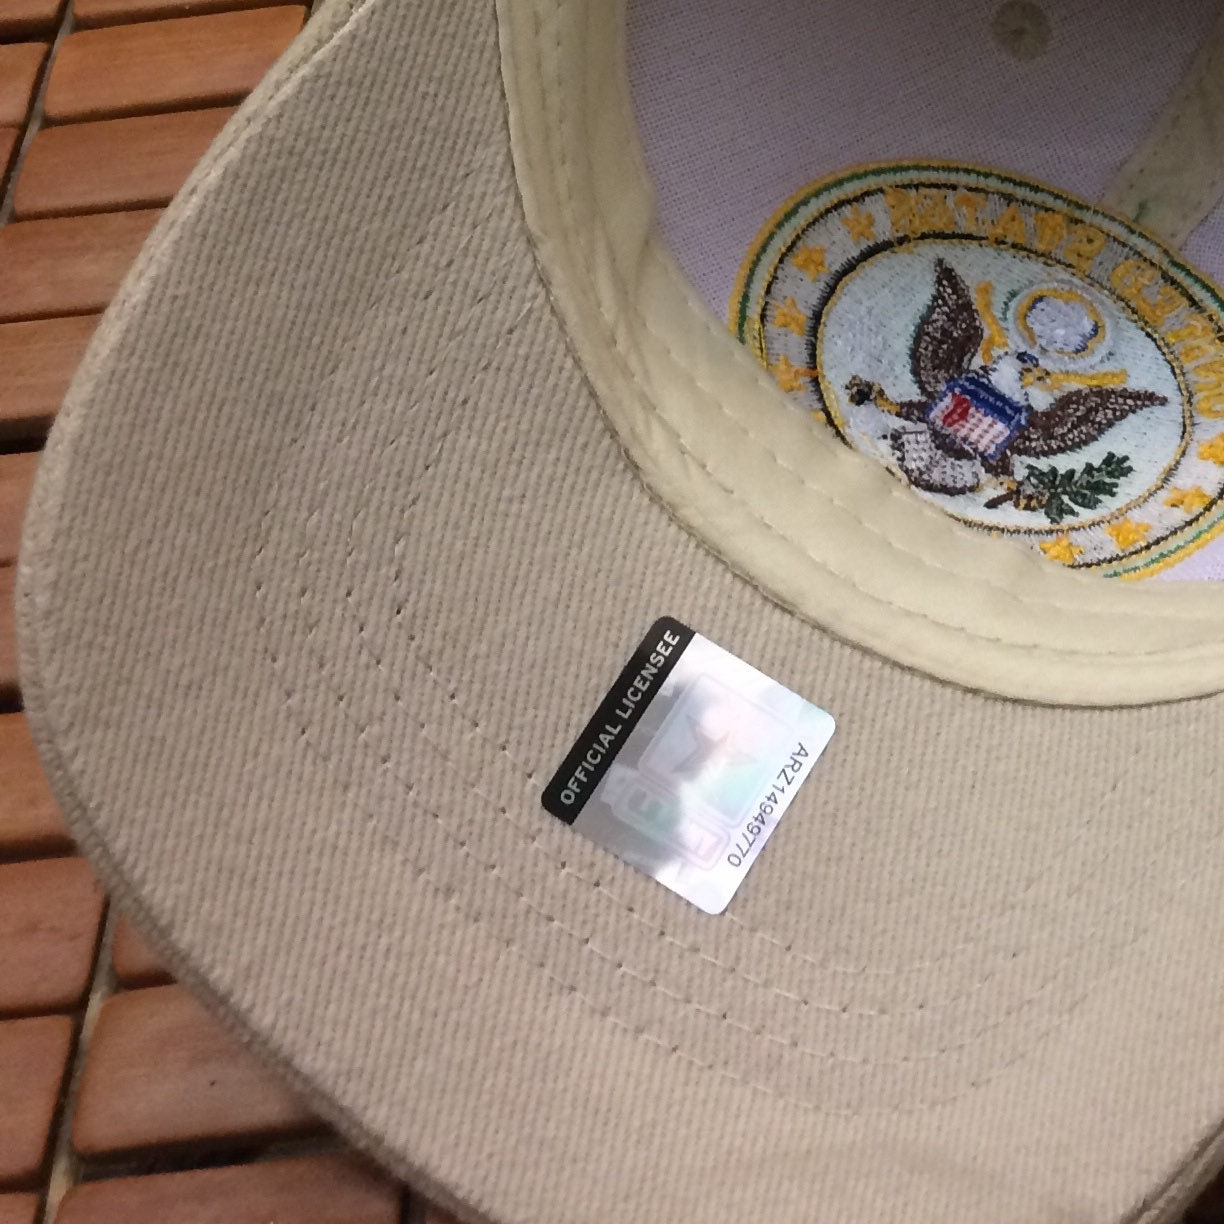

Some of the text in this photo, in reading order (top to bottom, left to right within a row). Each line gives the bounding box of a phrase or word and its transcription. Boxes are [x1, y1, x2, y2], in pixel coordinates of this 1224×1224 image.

[560, 629, 681, 806] OFFICIAL LICENSEE
[727, 741, 810, 867] ARZ14949770
